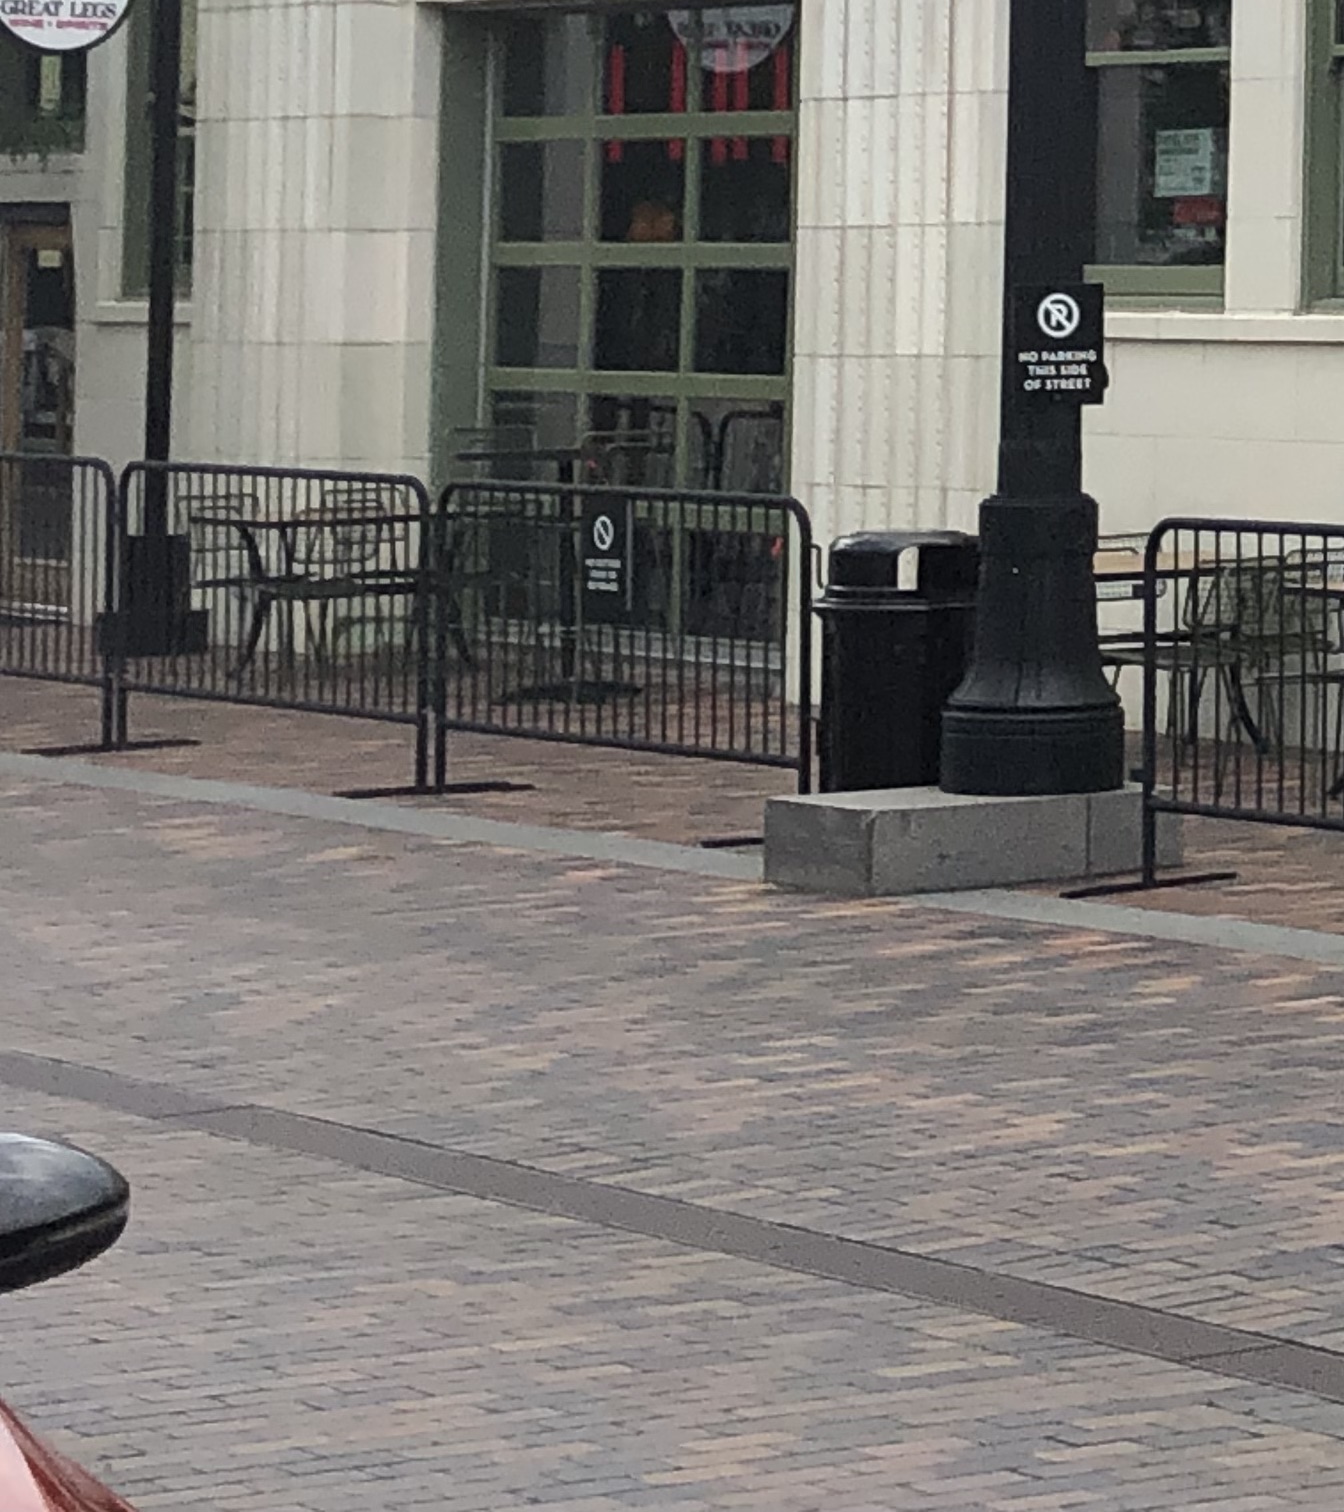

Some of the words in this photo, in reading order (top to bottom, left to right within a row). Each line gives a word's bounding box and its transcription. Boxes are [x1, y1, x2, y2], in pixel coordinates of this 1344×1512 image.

[70, 0, 117, 19] LEGS
[1018, 350, 1038, 363] NO
[1041, 349, 1097, 363] PARKING
[1027, 364, 1057, 376] THIS
[1060, 364, 1088, 375] SIDE
[1023, 379, 1042, 391] OF
[1045, 377, 1092, 390] STREET
